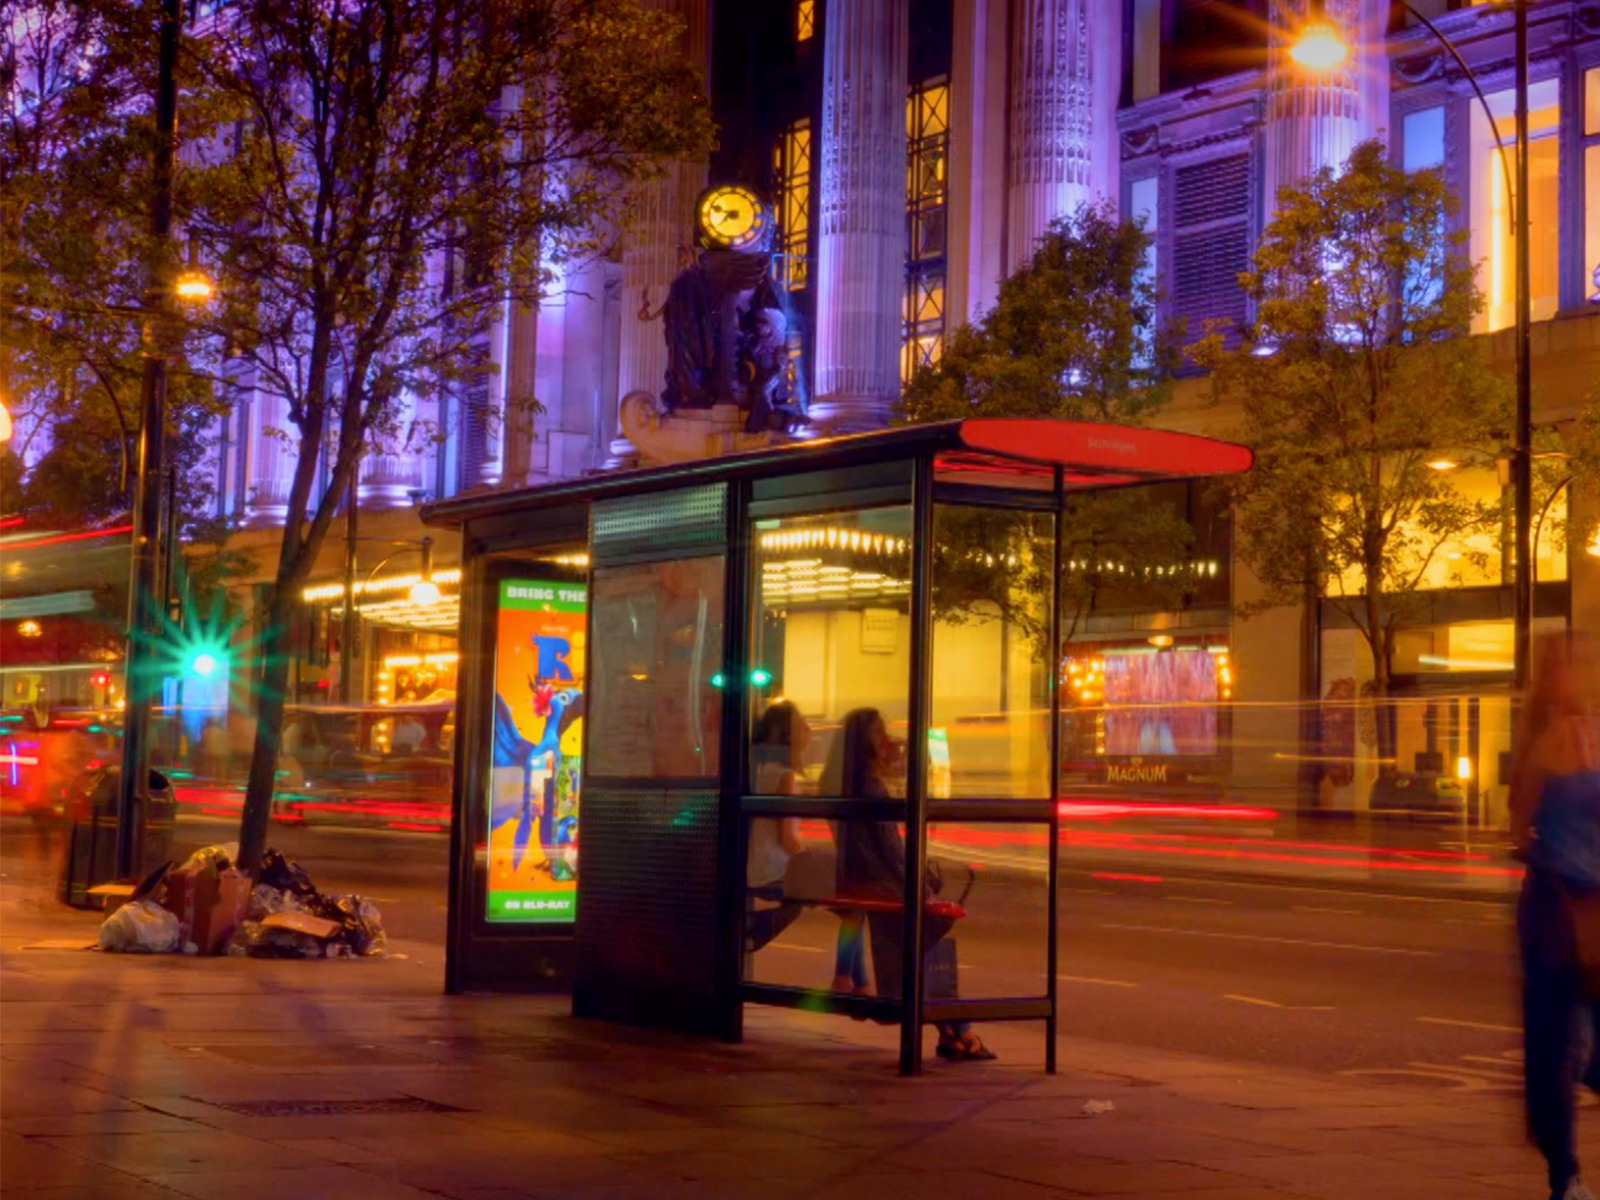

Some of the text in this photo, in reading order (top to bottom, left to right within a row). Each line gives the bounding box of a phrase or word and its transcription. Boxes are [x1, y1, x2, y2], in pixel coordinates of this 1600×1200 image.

[507, 586, 587, 603] BRING THE
[1107, 765, 1167, 782] MAGNUM
